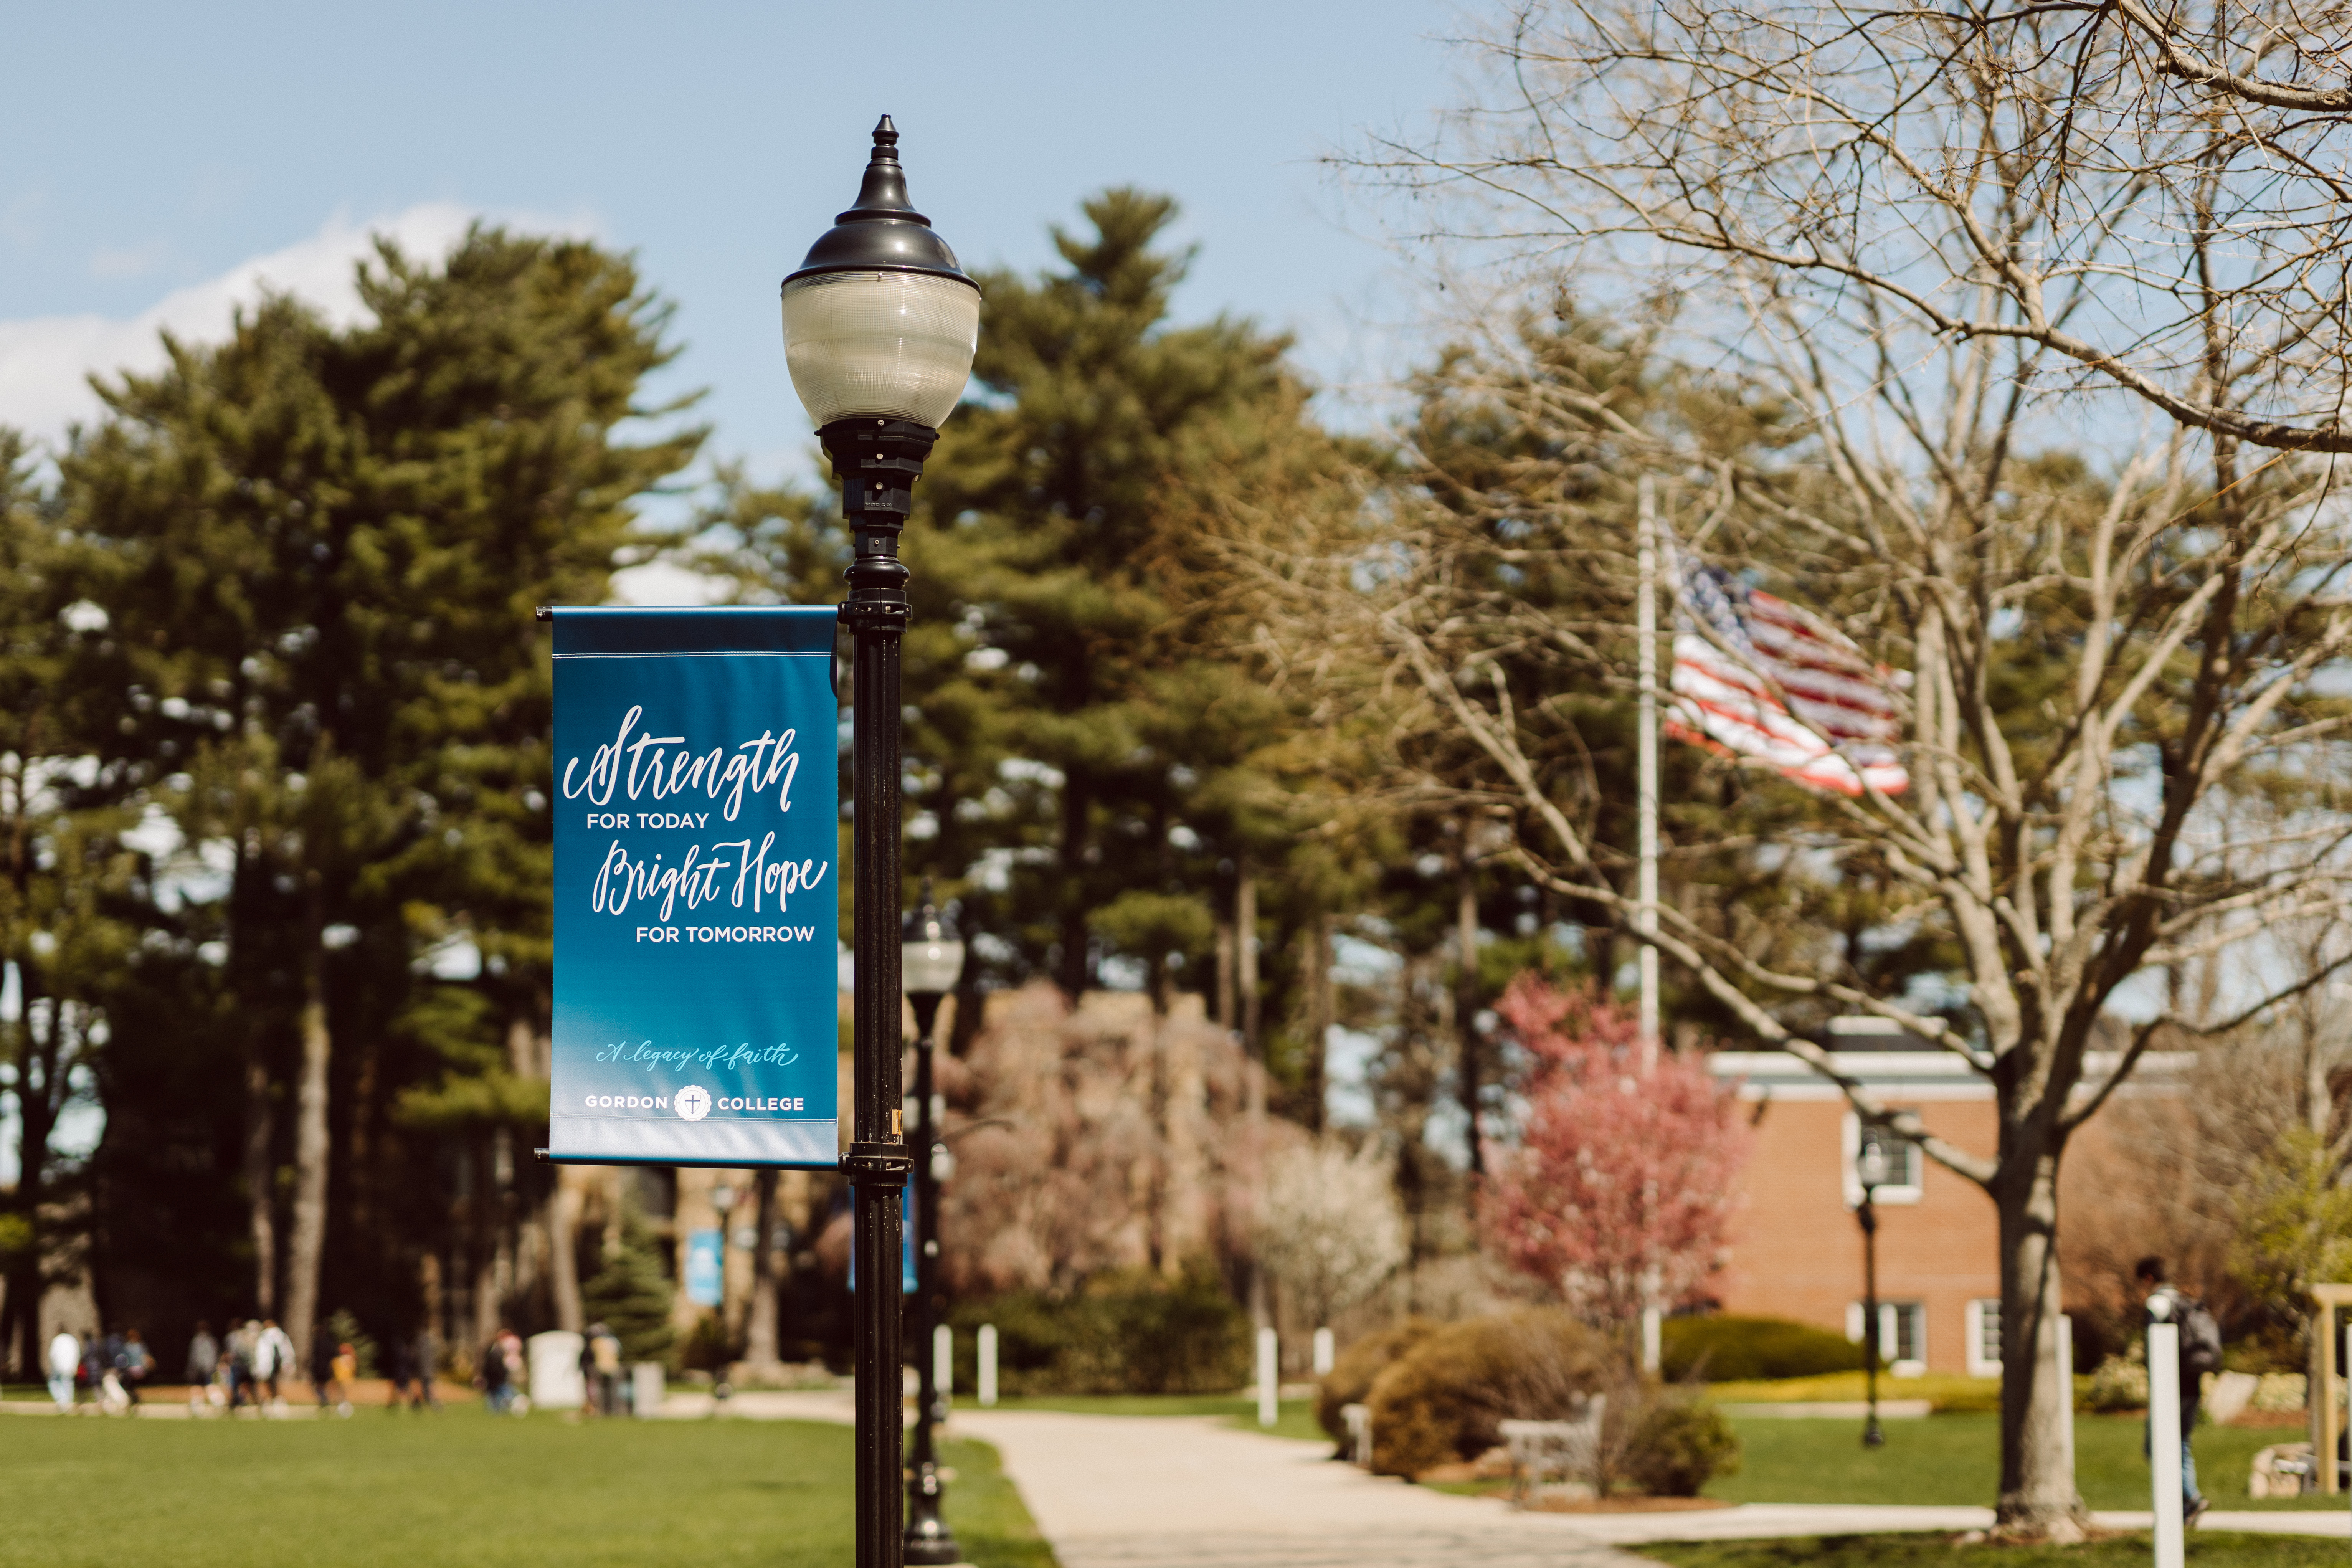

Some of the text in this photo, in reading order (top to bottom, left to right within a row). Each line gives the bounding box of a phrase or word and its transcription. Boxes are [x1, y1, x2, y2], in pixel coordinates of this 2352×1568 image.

[563, 705, 799, 821] Strength
[587, 813, 709, 829] FOR TODAY
[592, 831, 828, 922] Bright Hope
[636, 926, 815, 943] FOR TOMORROW
[596, 1040, 799, 1072] A legacy of faith
[585, 1095, 804, 1110] GORDON COLLEGE
